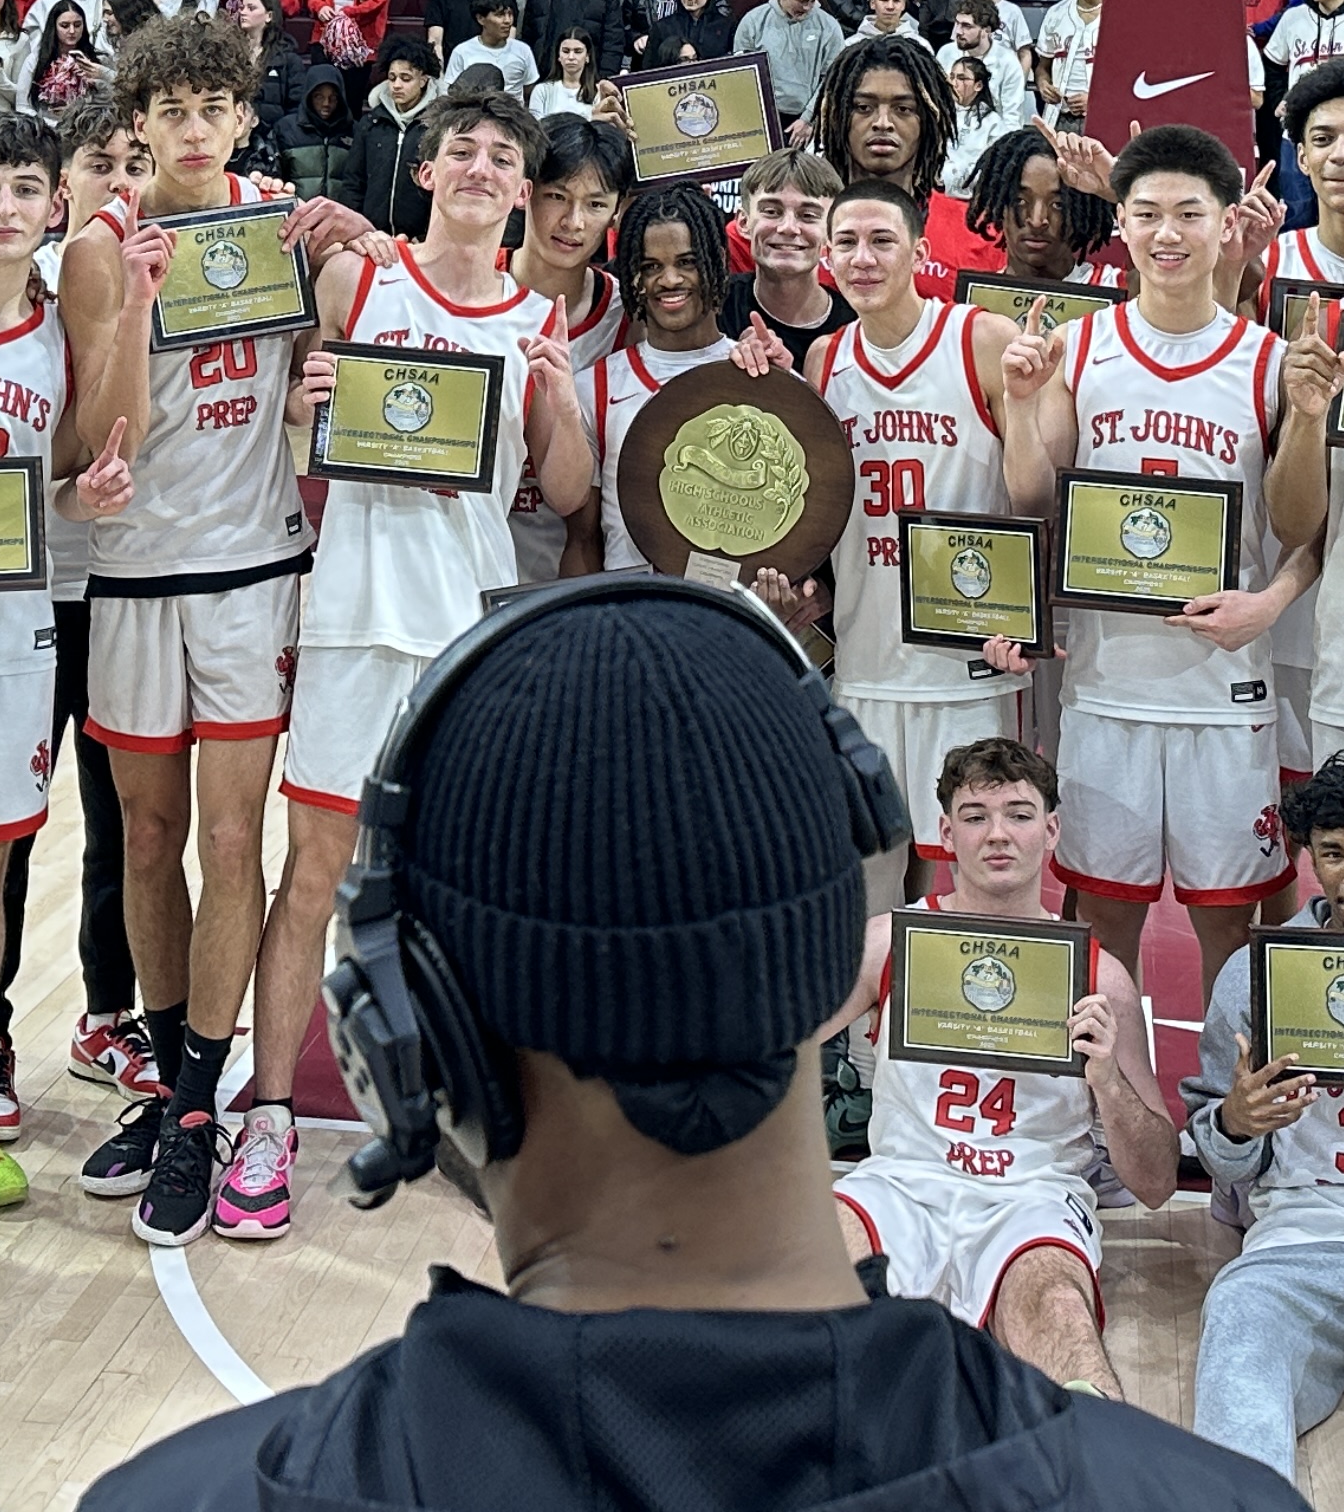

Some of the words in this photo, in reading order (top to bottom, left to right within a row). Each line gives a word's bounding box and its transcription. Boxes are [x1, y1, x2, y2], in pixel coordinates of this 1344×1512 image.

[668, 79, 717, 97] CHSAA
[195, 226, 246, 244] CHSAA
[384, 368, 440, 385] CHSAA
[196, 395, 257, 431] PREP
[841, 415, 860, 449] T.
[863, 410, 958, 446] JOHN'S
[1091, 409, 1125, 449] ST.
[1130, 409, 1238, 465] JOHN'S
[670, 480, 703, 498] HIGH
[705, 488, 764, 510] SCHOOLS
[860, 459, 925, 517] 30
[698, 503, 753, 524] ATHLETIC
[1120, 494, 1176, 510] CHSAA
[686, 516, 764, 541] ASSOCIATION
[868, 537, 900, 566] PR
[948, 535, 993, 550] CHSAA
[960, 941, 1020, 959] CHSAA
[935, 1068, 1017, 1136] 24
[946, 1141, 1015, 1177] PREP
